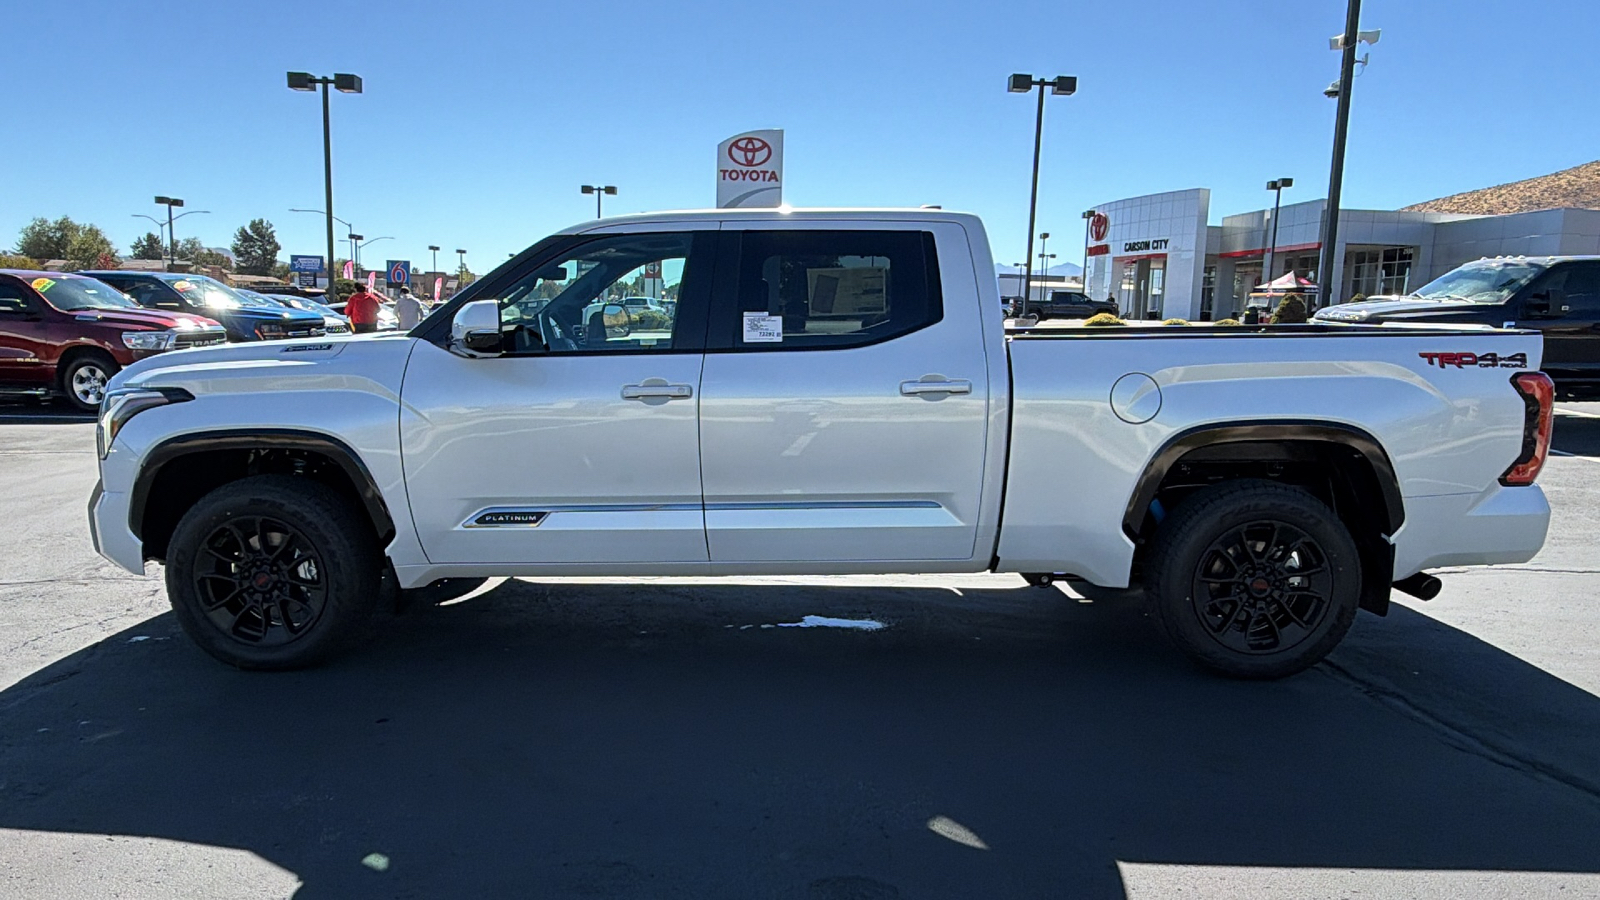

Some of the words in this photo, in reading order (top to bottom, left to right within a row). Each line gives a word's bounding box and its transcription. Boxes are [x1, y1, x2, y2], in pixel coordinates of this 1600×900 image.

[719, 169, 779, 182] TOYOTA
[1124, 240, 1150, 252] CARSON
[1151, 239, 1169, 250] CITY
[390, 261, 407, 284] 6
[1419, 352, 1477, 369] TRD
